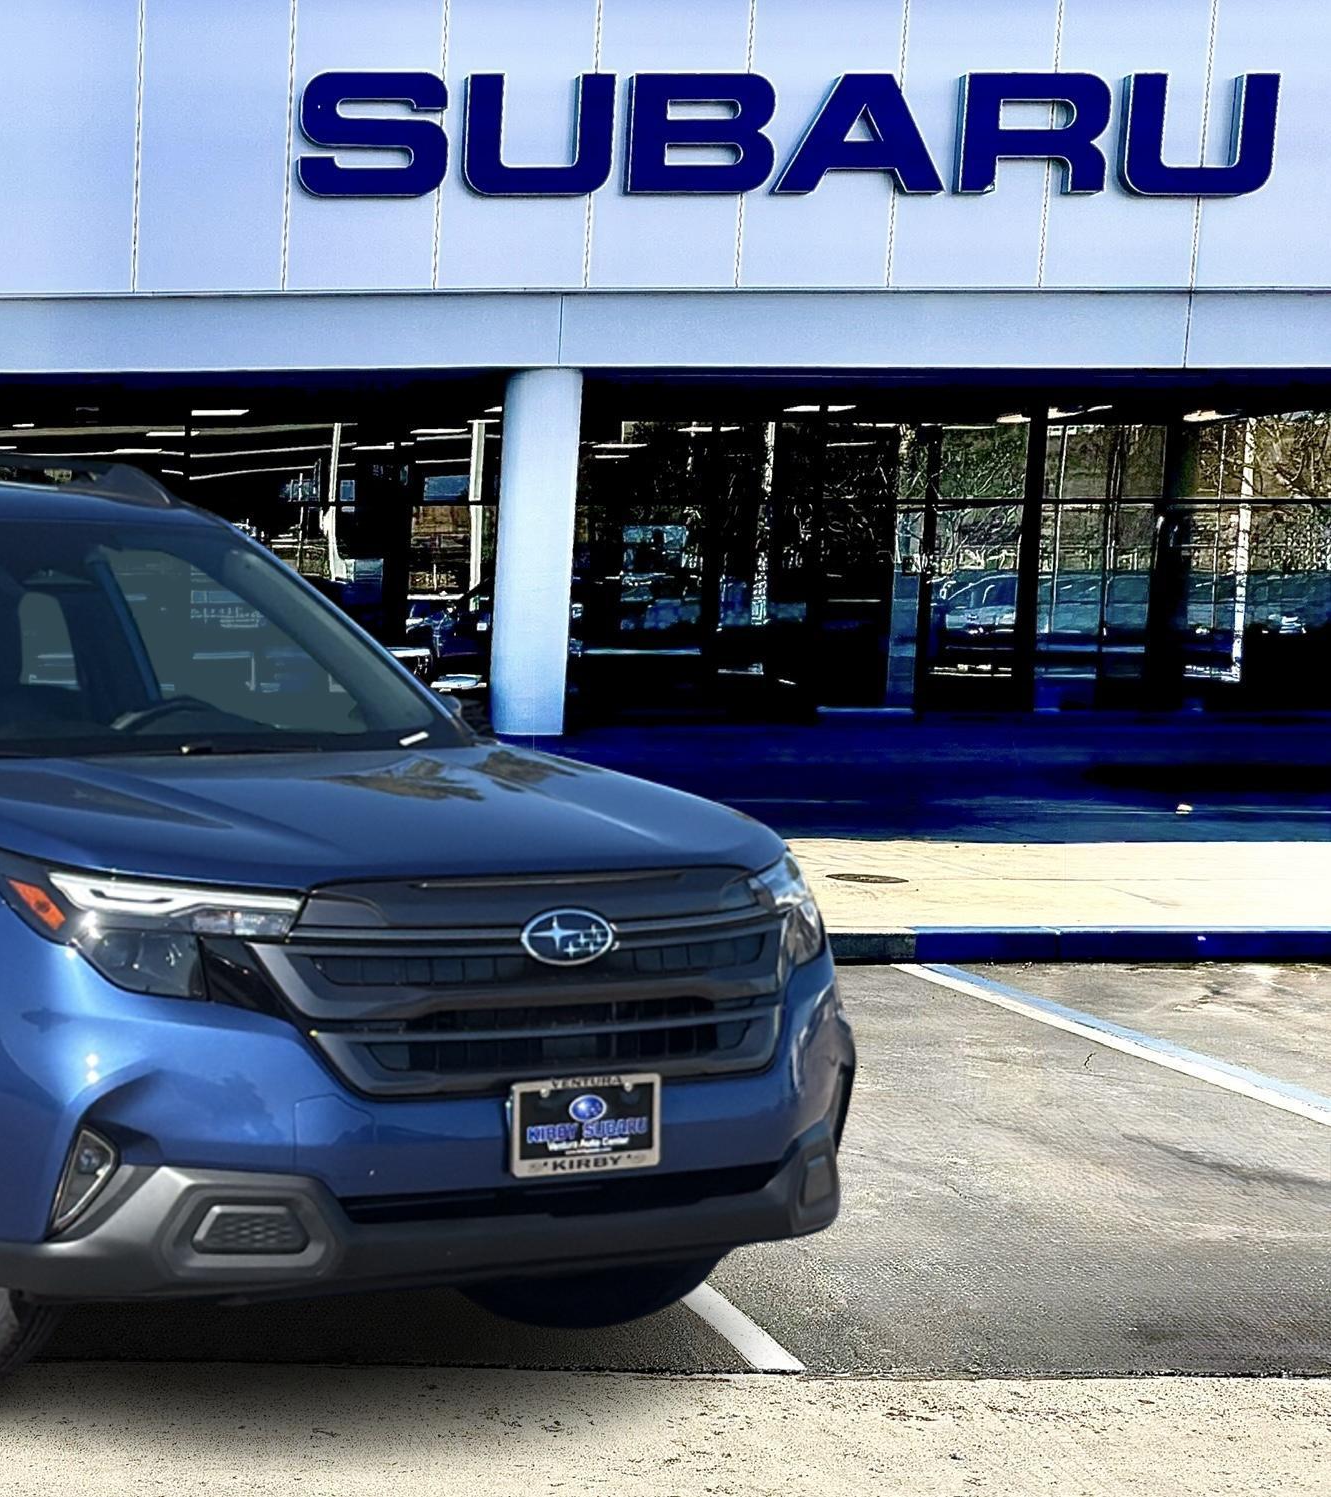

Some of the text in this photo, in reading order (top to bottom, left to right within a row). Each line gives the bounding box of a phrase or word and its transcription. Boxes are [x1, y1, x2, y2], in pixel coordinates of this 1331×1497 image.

[297, 72, 1281, 198] SUBARU
[552, 1075, 623, 1088] VENTURA
[527, 1117, 647, 1143] KIRBY SUBARU
[552, 1156, 622, 1171] KIRBY
